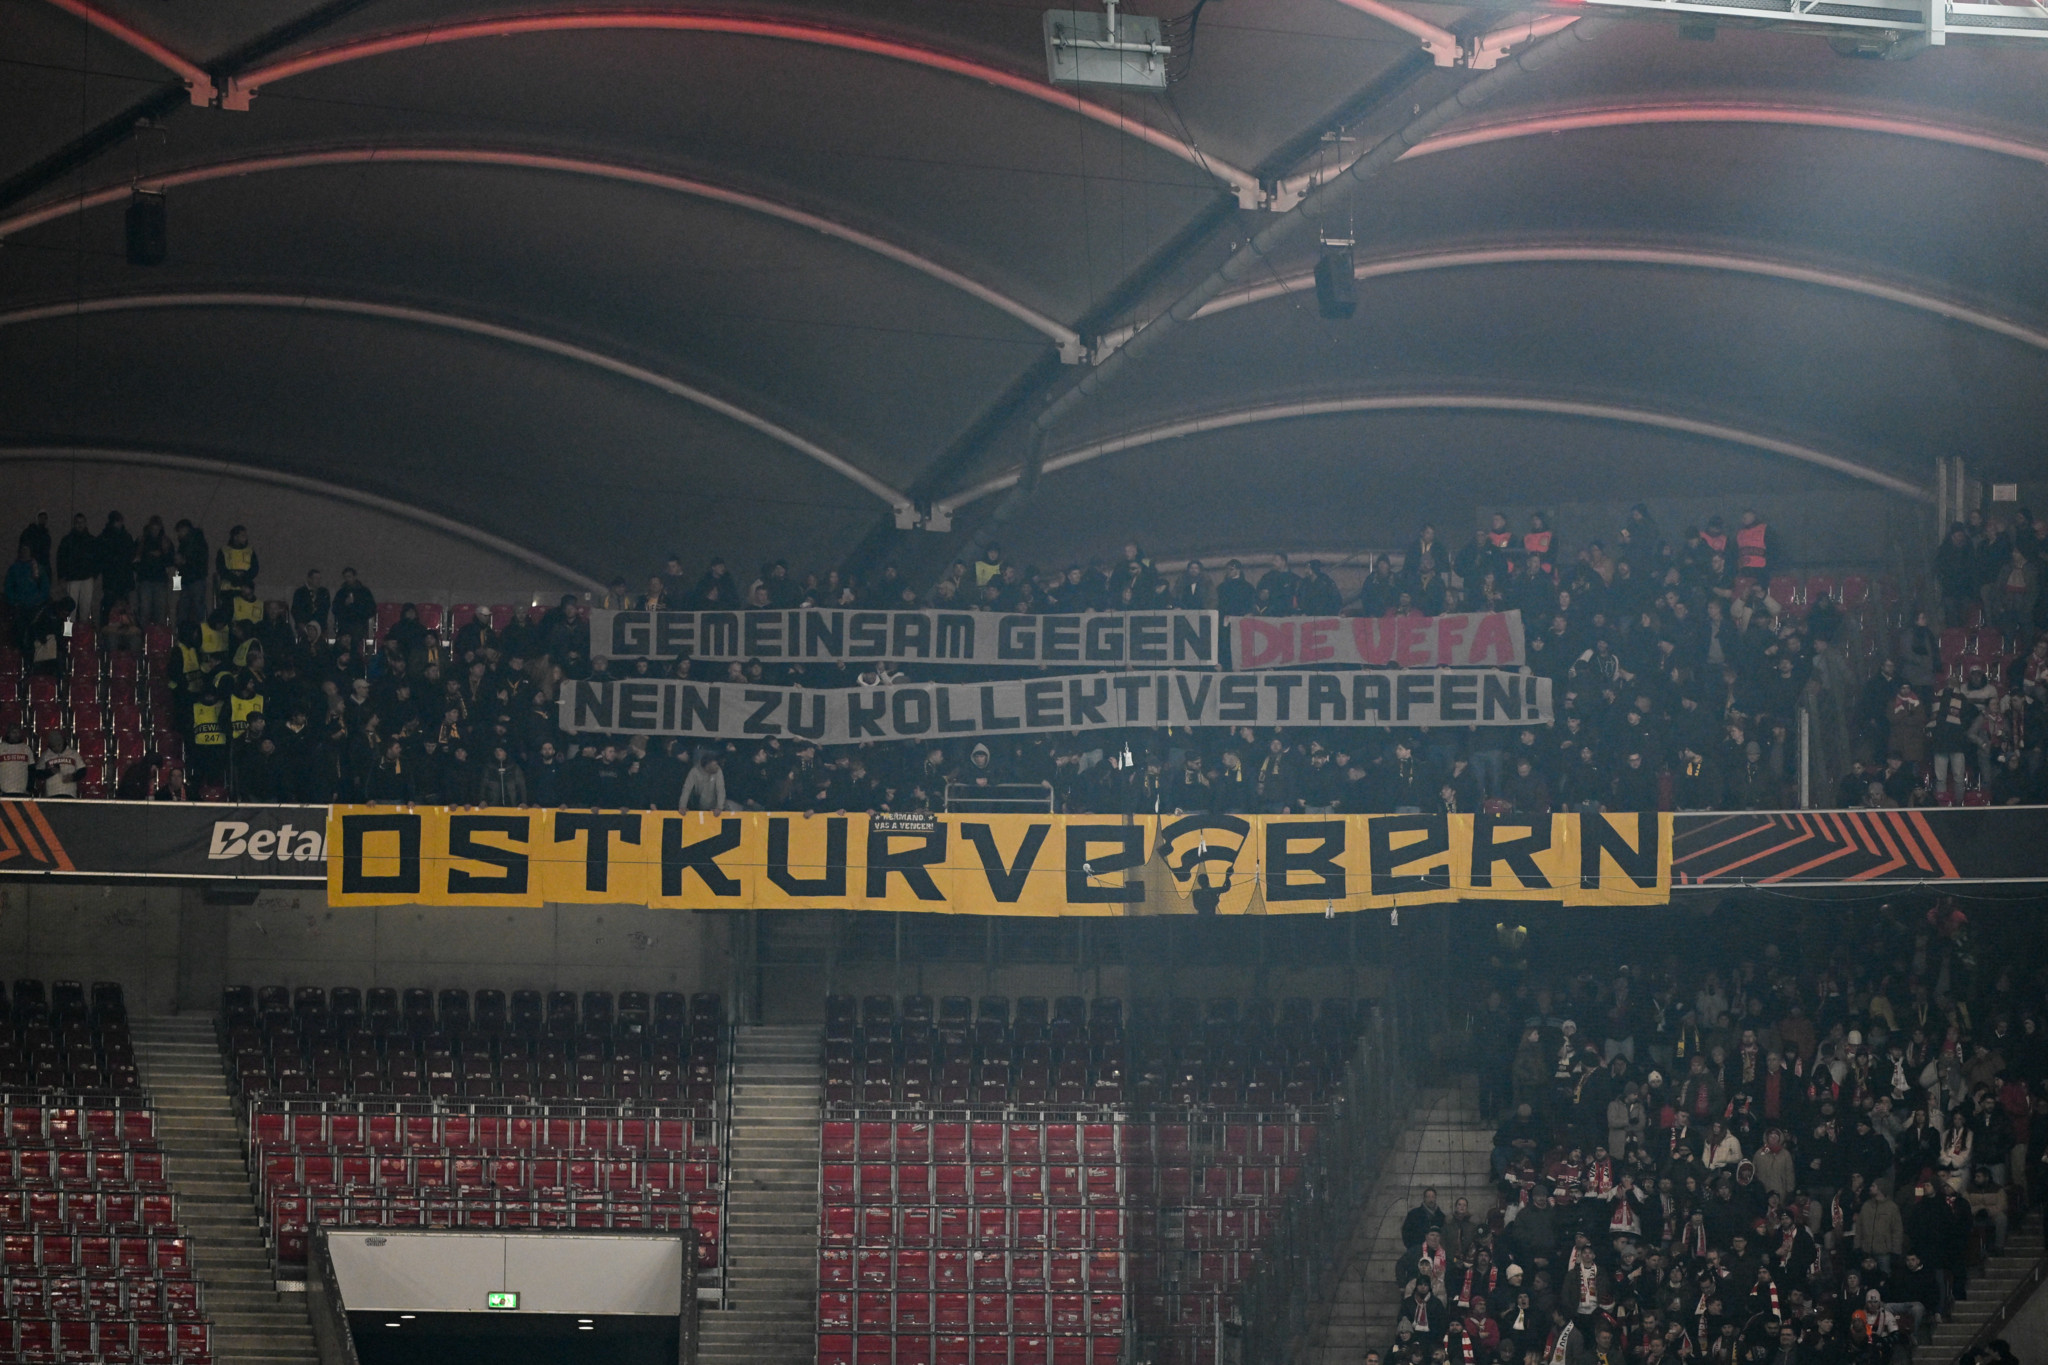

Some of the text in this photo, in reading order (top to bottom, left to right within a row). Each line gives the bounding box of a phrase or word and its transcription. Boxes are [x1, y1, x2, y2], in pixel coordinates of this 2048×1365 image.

[611, 611, 1213, 662] GEMEINSAM GEGEN
[1240, 611, 1516, 669] DIE UEFA
[574, 673, 1541, 740] NEIN ZU KOLLEKTIVSTRAFEN!
[204, 734, 221, 743] 247
[891, 822, 898, 830] A
[342, 811, 1660, 905] OSTKURVE BERN
